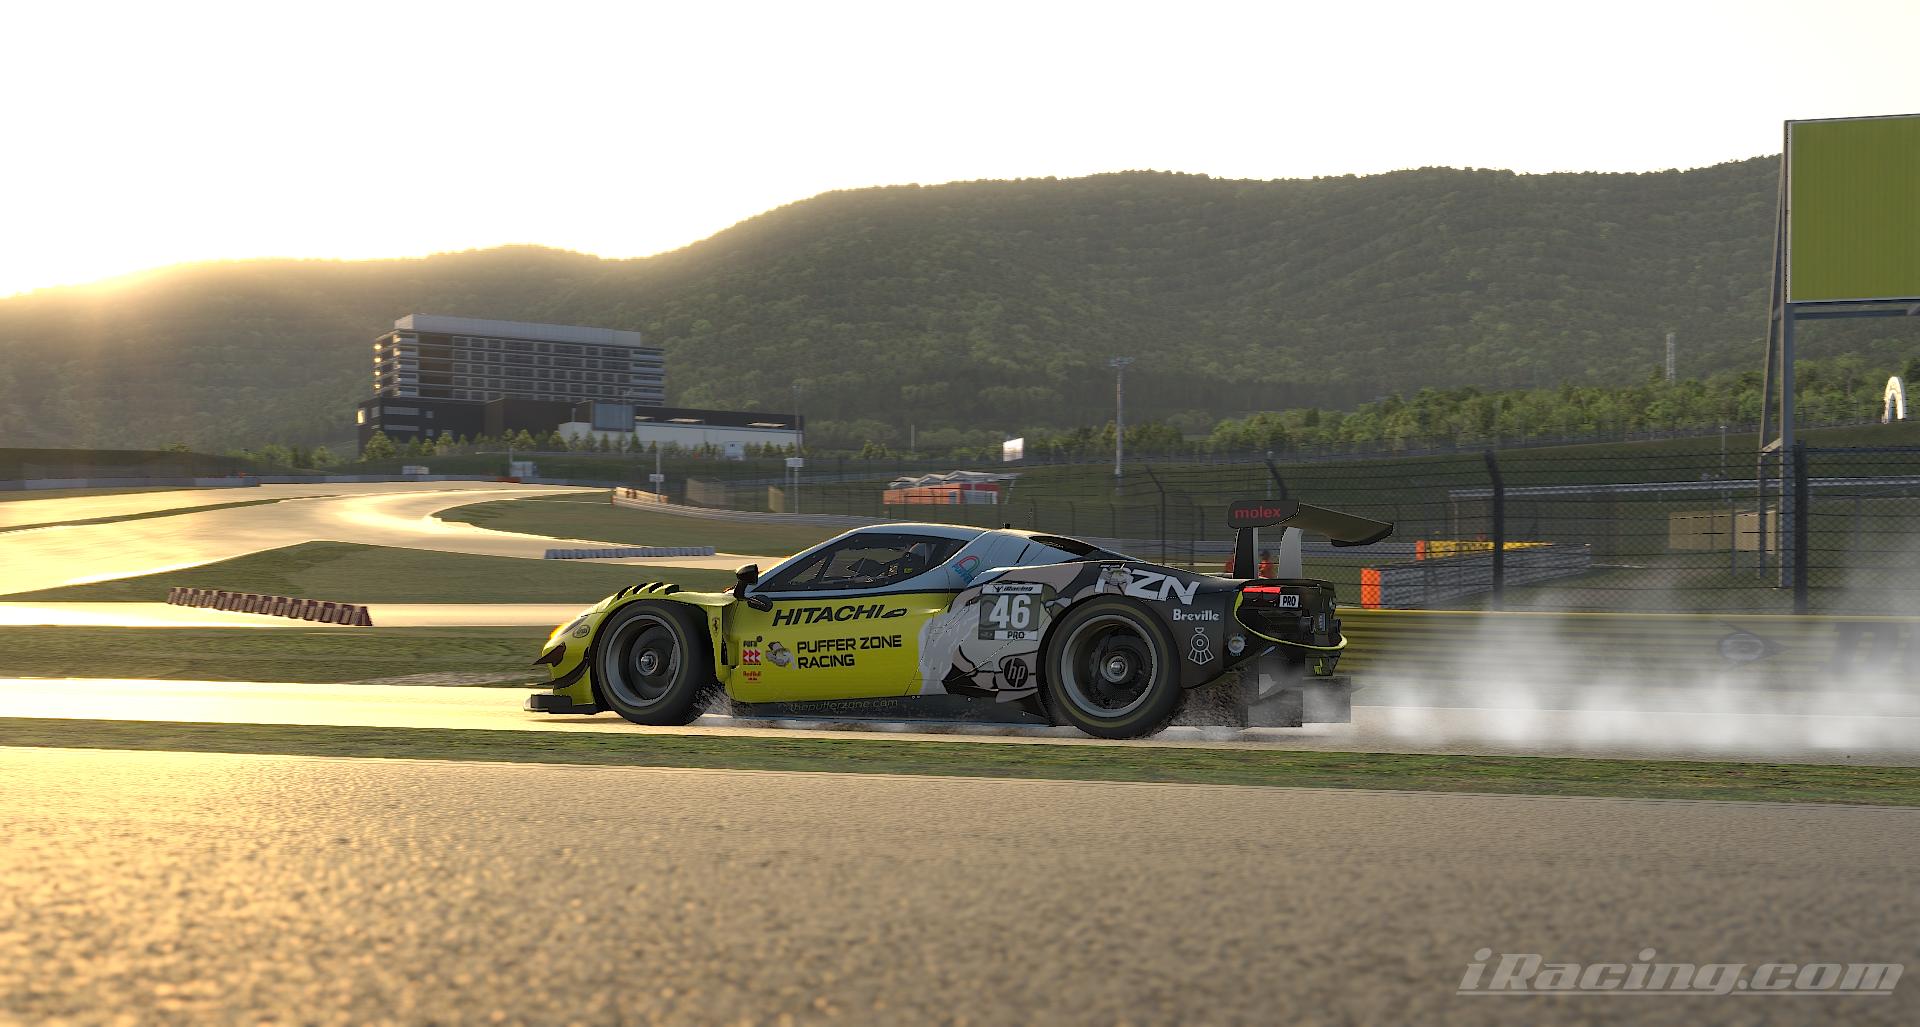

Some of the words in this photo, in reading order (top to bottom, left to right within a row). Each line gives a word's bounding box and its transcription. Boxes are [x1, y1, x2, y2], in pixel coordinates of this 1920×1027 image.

[1234, 506, 1281, 519] molex
[1283, 596, 1296, 606] PRO
[772, 604, 883, 626] HITACHI
[989, 595, 1031, 629] 46
[1172, 608, 1220, 622] Breville
[1007, 631, 1025, 639] PRO
[797, 638, 856, 653] PUFFER
[859, 635, 902, 649] ZONE
[798, 654, 855, 669] RACING
